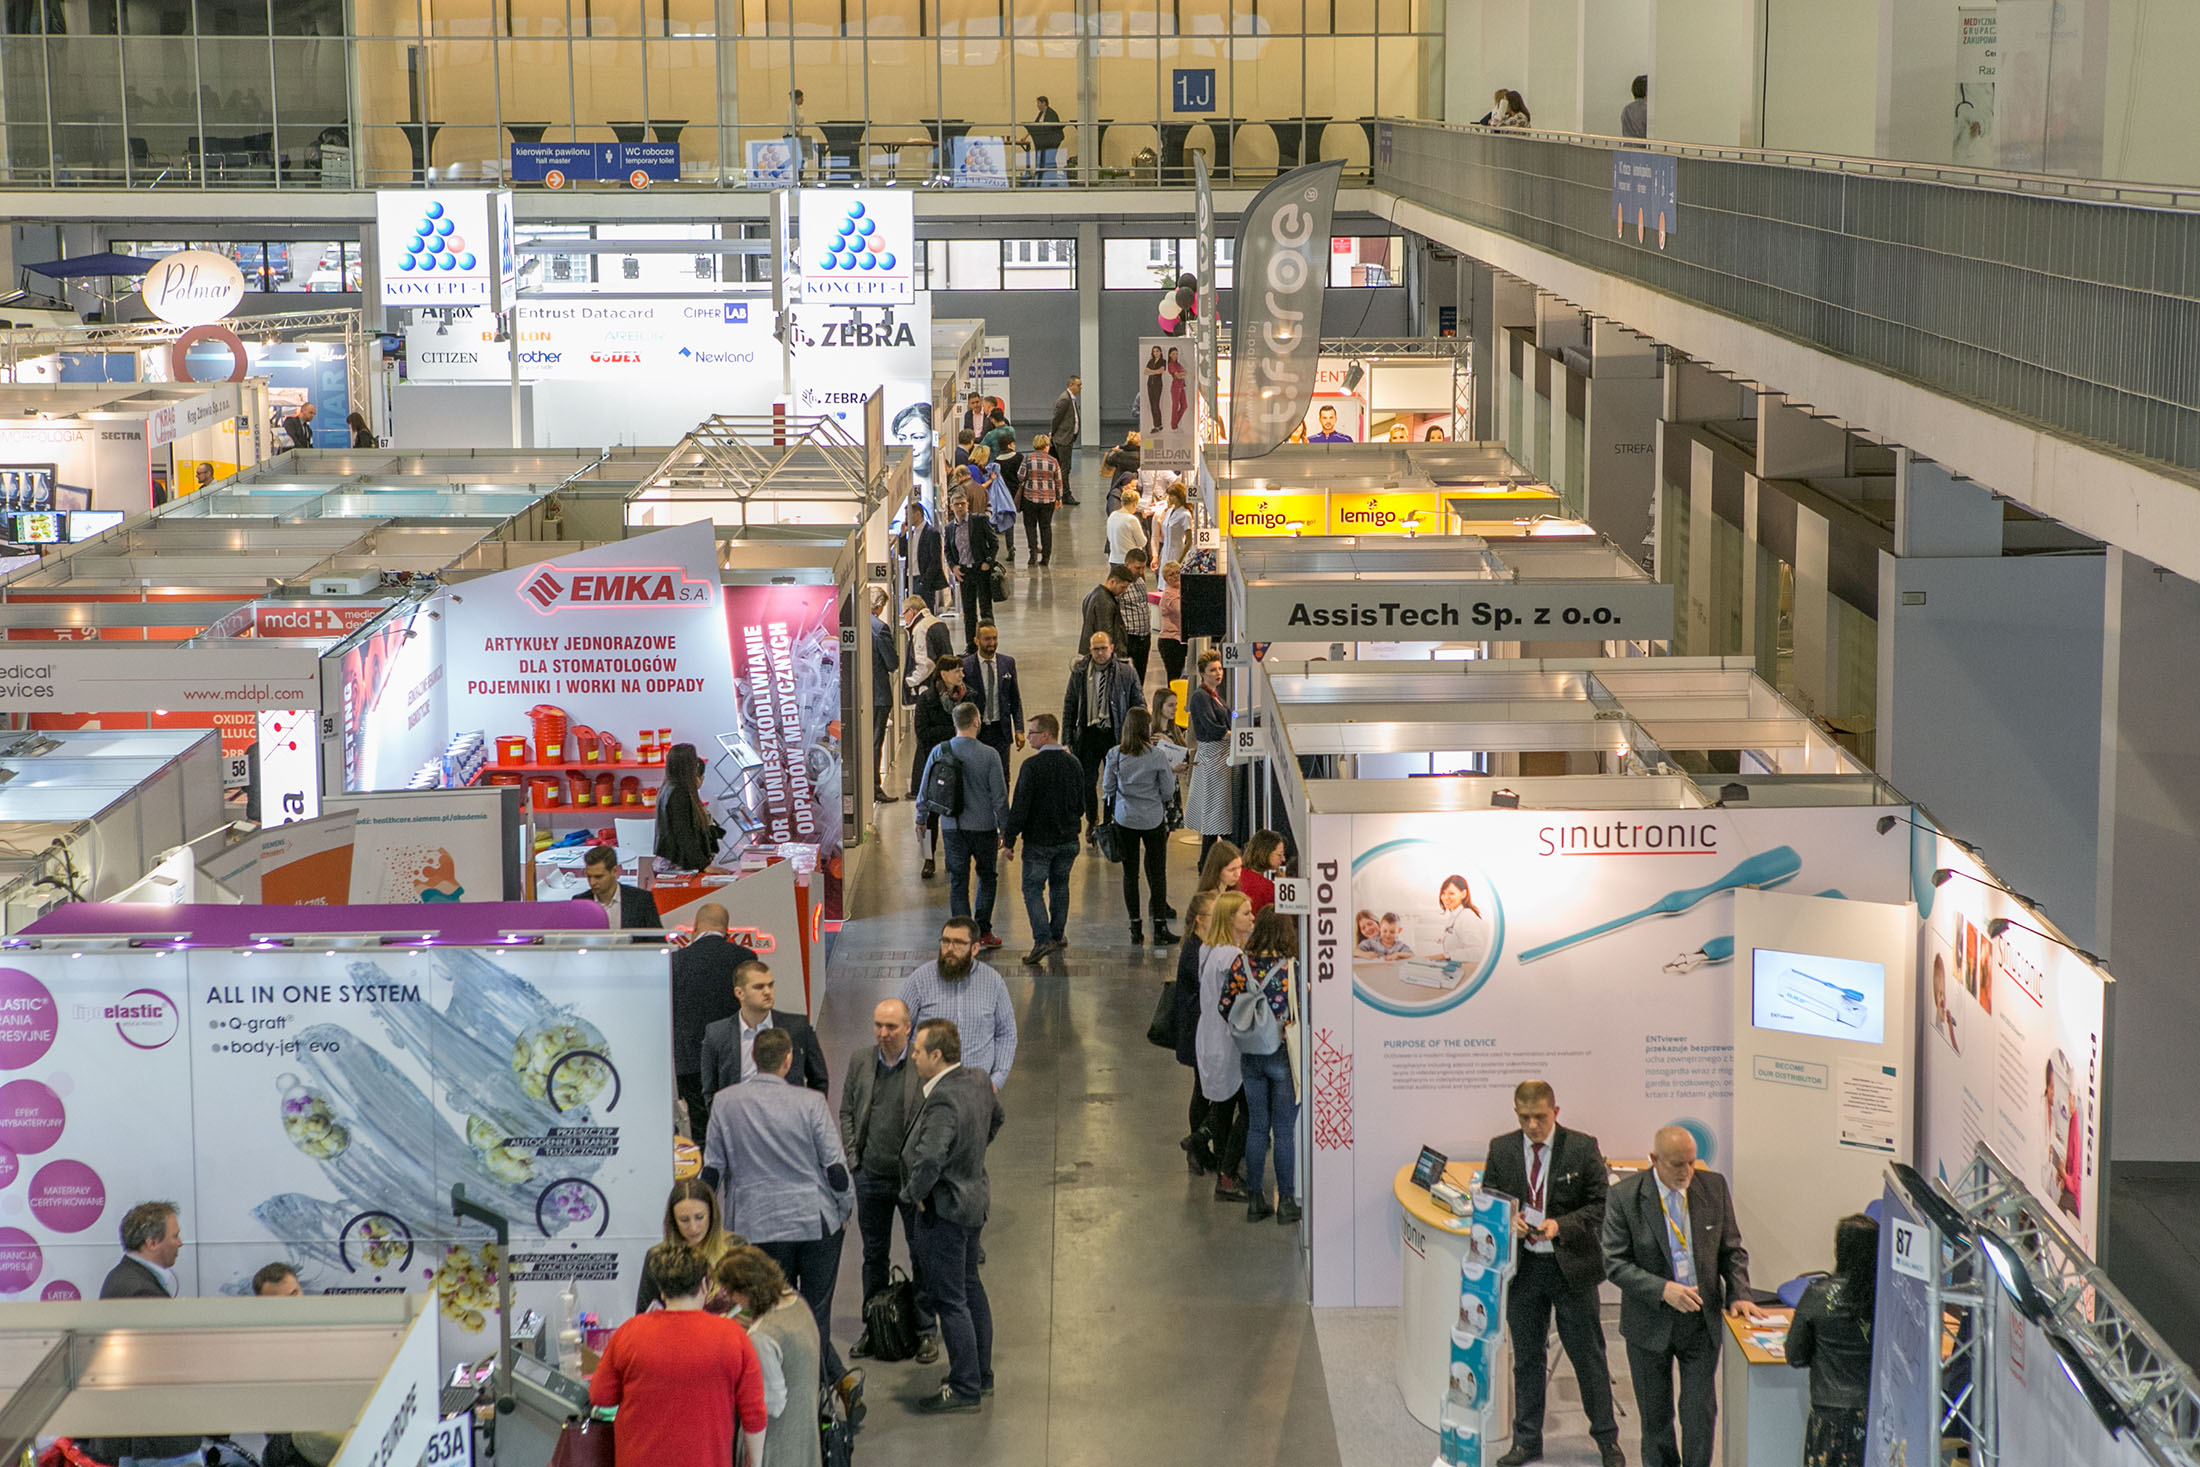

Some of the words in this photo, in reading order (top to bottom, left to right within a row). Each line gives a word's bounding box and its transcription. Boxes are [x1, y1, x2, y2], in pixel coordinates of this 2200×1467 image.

[1177, 75, 1210, 106] 1.J
[516, 147, 554, 156] kierownik
[555, 147, 590, 157] pawilonu
[625, 147, 640, 156] WC
[642, 147, 674, 156] robocze
[536, 157, 548, 165] hall
[659, 157, 674, 165] toilet
[160, 262, 231, 307] Polmar
[519, 308, 575, 319] Entrust
[582, 308, 653, 319] Datacard
[725, 306, 747, 319] LAB
[821, 322, 916, 347] ZEBRA
[421, 353, 478, 364] CITIZEN
[695, 351, 754, 363] Newland
[387, 362, 394, 370] 25
[824, 392, 868, 404] ZEBRA
[101, 431, 141, 440] SECTRA
[381, 439, 388, 448] 67
[1615, 444, 1654, 454] STREFA
[1188, 487, 1197, 497] 82
[1230, 510, 1286, 528] lemigo
[1341, 508, 1396, 527] lemigo
[1200, 532, 1210, 542] 83
[875, 566, 887, 577] 65
[570, 575, 677, 602] EMKA
[265, 612, 310, 628] mdd
[1288, 603, 1459, 626] AssisTech
[1471, 602, 1522, 630] Sp.
[1534, 607, 1551, 625] z
[1561, 606, 1622, 625] o.o.
[484, 633, 559, 652] ARTYKUŁY
[563, 634, 676, 652] JEDNORAZOWE
[842, 630, 855, 644] 66
[1225, 647, 1238, 660] 84
[519, 659, 549, 674] DLA
[552, 655, 677, 674] STOMATOLOGÓW
[468, 679, 551, 695] POJEMNIKI
[556, 680, 561, 694] I
[567, 679, 616, 694] WORKI
[621, 678, 641, 693] NA
[646, 676, 705, 694] ODPADY
[768, 621, 802, 742] MEDYCZNYCH
[184, 684, 304, 703] www.mddpl.com
[744, 624, 785, 802] UNIESZKODLIWIANIE
[323, 718, 333, 733] 59
[1239, 732, 1254, 747] 85
[232, 760, 246, 776] 58
[786, 748, 814, 835] ODPADÓW
[1538, 820, 1717, 857] sinutronic
[1279, 883, 1295, 901] 86
[1317, 859, 1338, 983] Polska
[207, 986, 244, 1003] ALL
[252, 986, 274, 1003] IN
[283, 985, 331, 1003] ONE
[339, 984, 421, 1003] SYSTEM
[1383, 1040, 1426, 1048] PURPOSE
[1428, 1040, 1440, 1048] OF
[1443, 1039, 1461, 1047] THE
[1463, 1039, 1496, 1047] DEVICE
[1645, 1035, 1687, 1043] ENTviewer
[309, 1041, 340, 1053] evo
[1758, 1069, 1774, 1078] OUR
[1775, 1072, 1822, 1085] DISTRIBUTOR
[1896, 1228, 1912, 1258] 87
[428, 1425, 465, 1464] 53A
